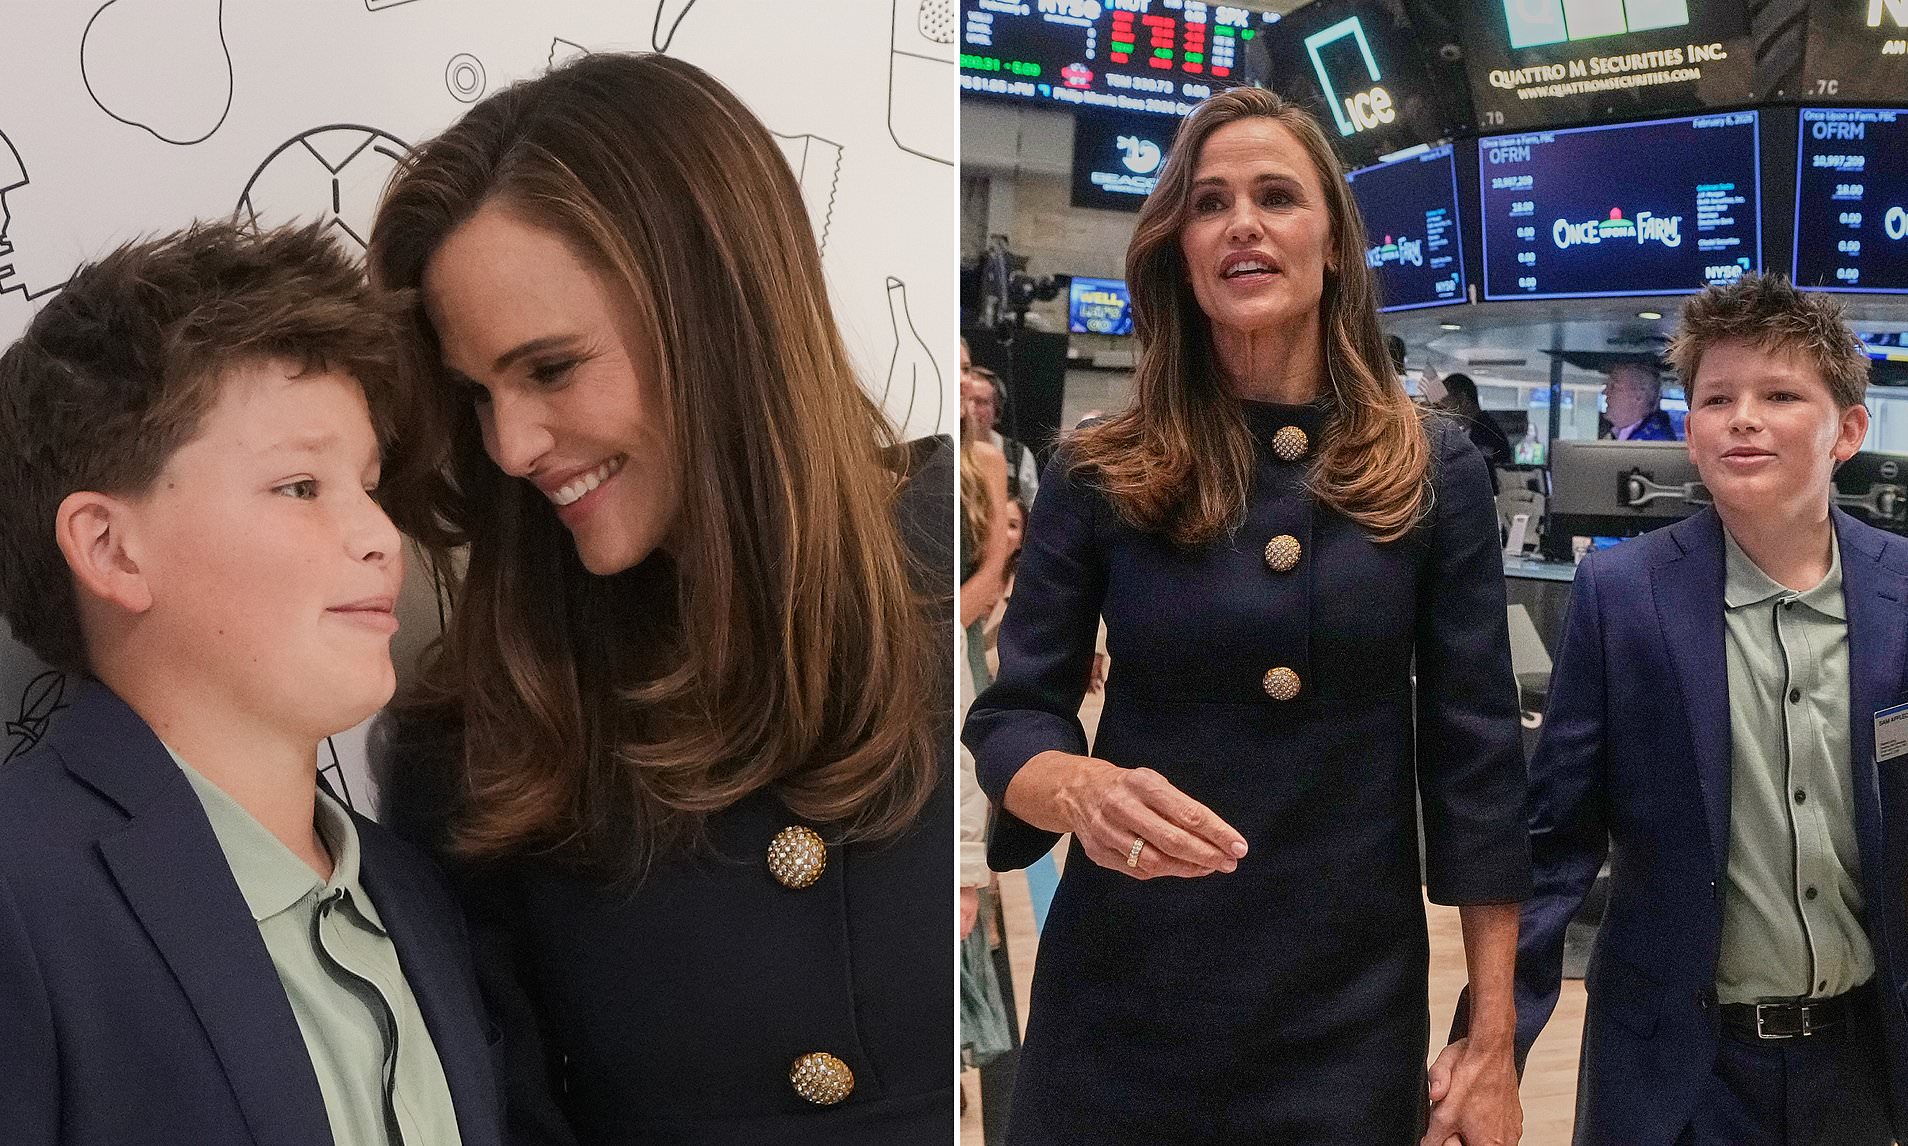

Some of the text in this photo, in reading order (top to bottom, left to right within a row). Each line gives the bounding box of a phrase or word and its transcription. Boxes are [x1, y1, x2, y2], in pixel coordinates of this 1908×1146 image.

[1489, 43, 1728, 89] QUATTRO M SECURITIES INC.
[1812, 122, 1865, 140] OFRM
[1489, 145, 1531, 164] OFRM
[1553, 218, 1601, 249] ONCE
